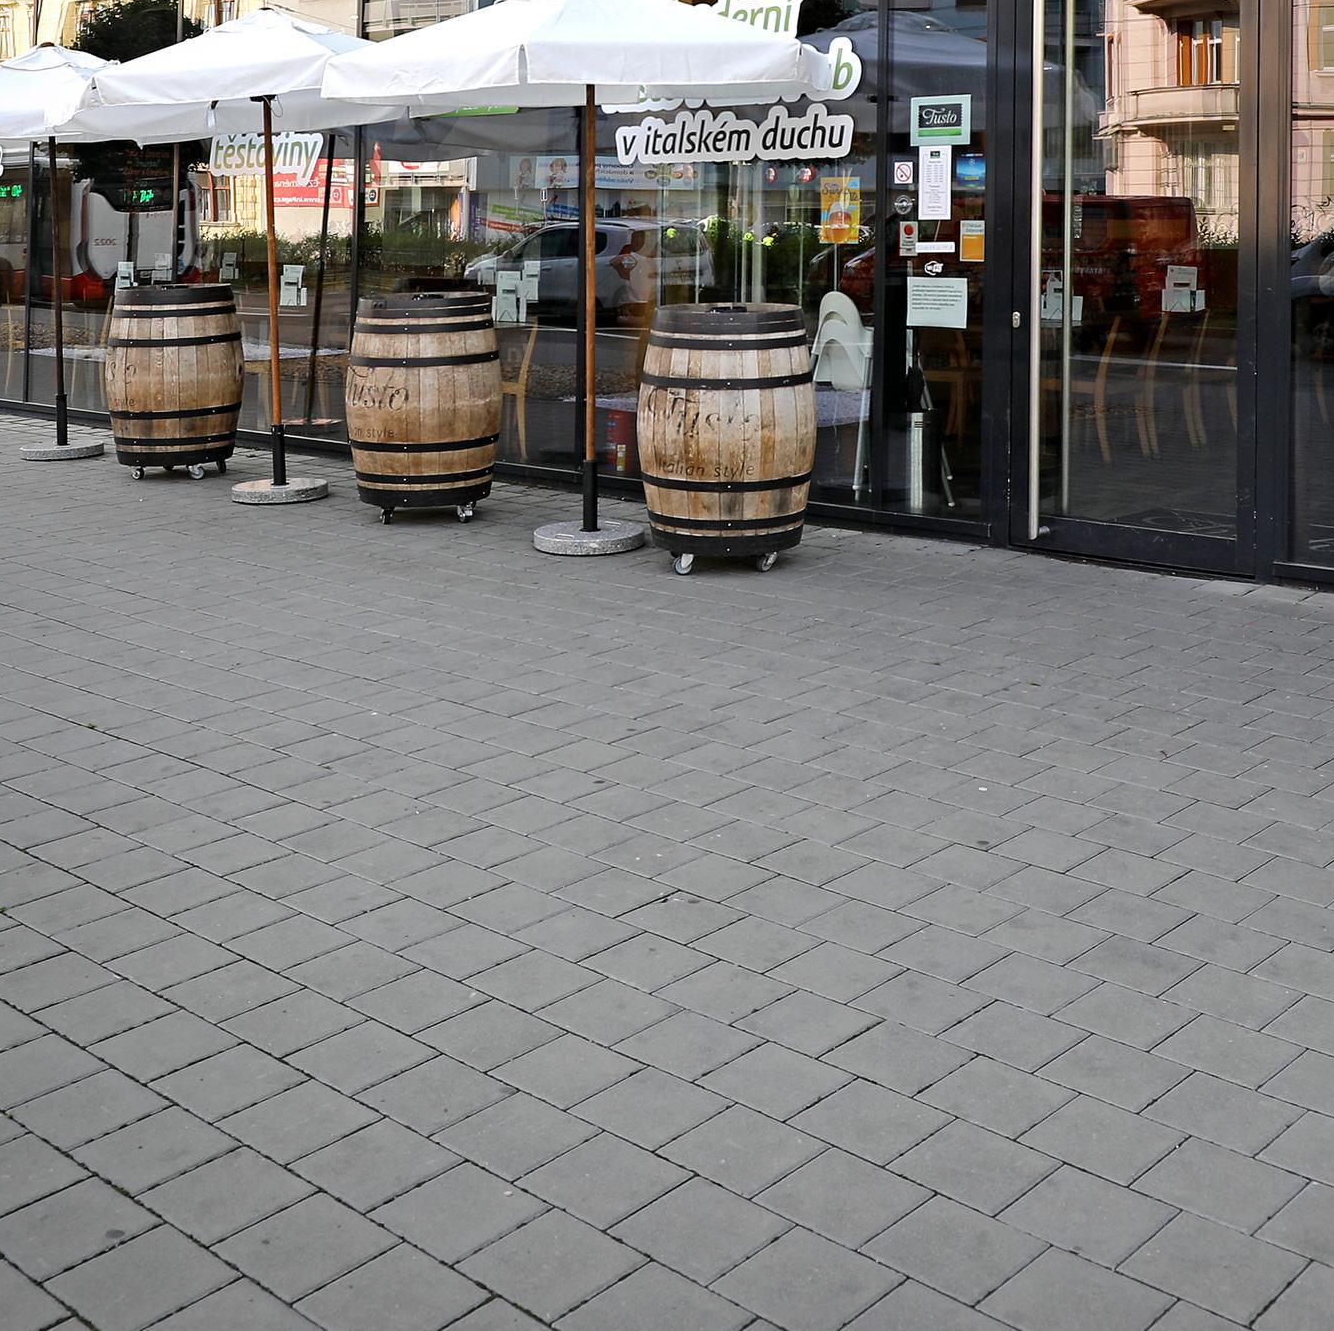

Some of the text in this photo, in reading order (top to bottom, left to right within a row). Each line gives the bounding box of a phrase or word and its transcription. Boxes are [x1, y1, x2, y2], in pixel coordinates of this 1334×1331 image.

[922, 108, 958, 125] Tusto
[622, 113, 846, 156] v italském duchu
[213, 132, 319, 179] těstoviny
[714, 460, 756, 480] style
